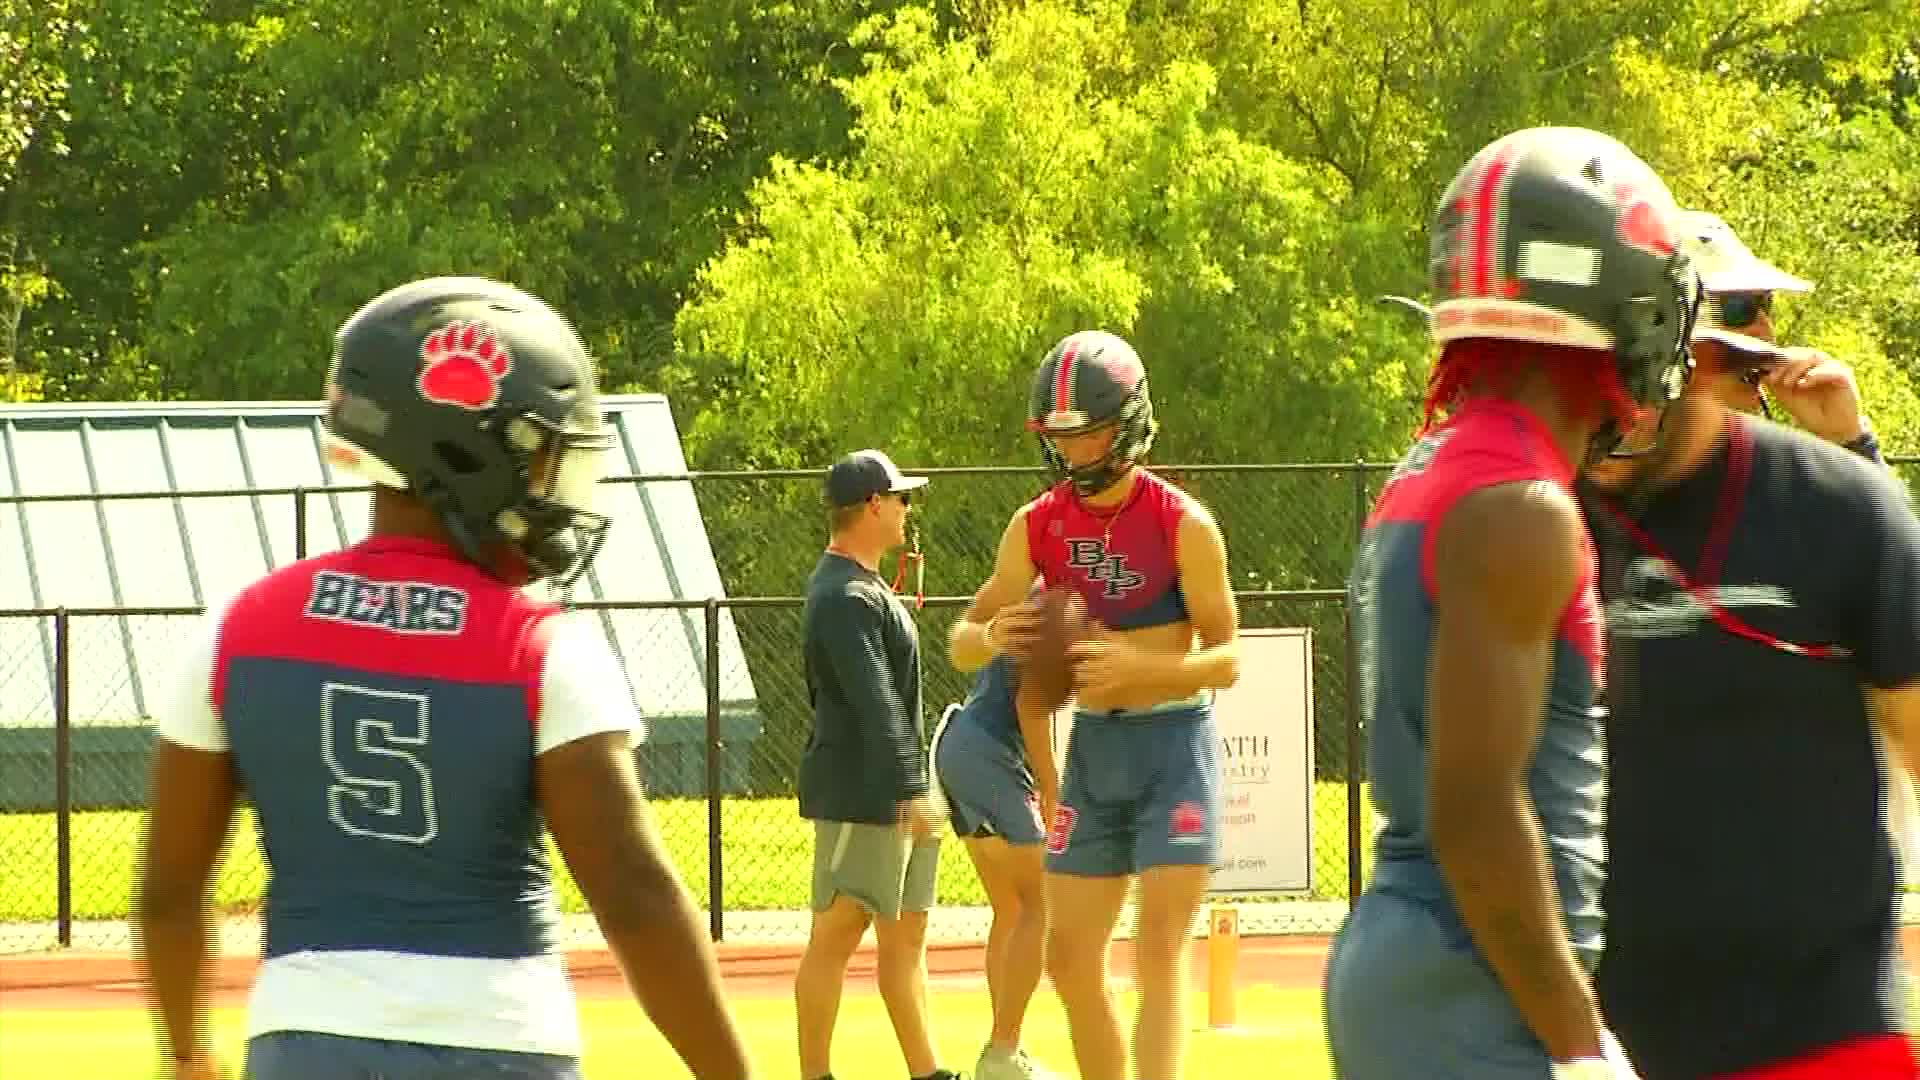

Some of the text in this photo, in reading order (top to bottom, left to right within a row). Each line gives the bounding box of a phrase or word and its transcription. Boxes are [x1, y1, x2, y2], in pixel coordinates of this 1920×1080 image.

[1064, 537, 1146, 599] BHP
[304, 570, 469, 634] BEARS
[320, 681, 438, 844] 5
